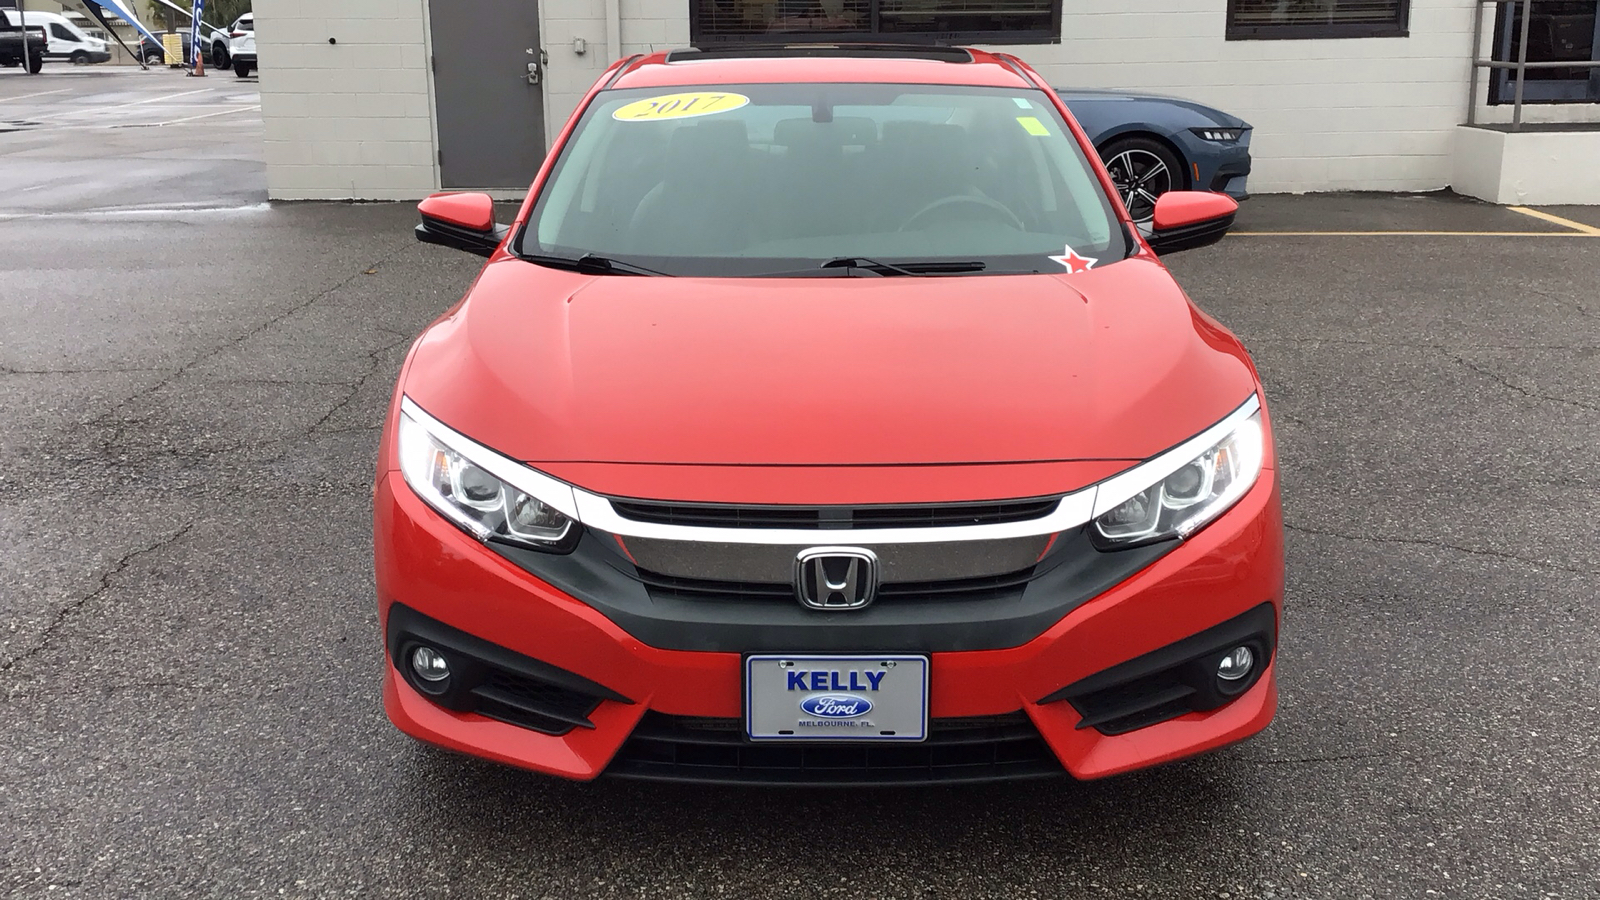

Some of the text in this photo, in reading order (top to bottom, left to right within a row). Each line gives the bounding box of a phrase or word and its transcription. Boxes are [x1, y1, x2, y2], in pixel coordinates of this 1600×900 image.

[633, 95, 727, 118] 2017
[787, 671, 886, 691] KELLY
[814, 697, 859, 715] Ford
